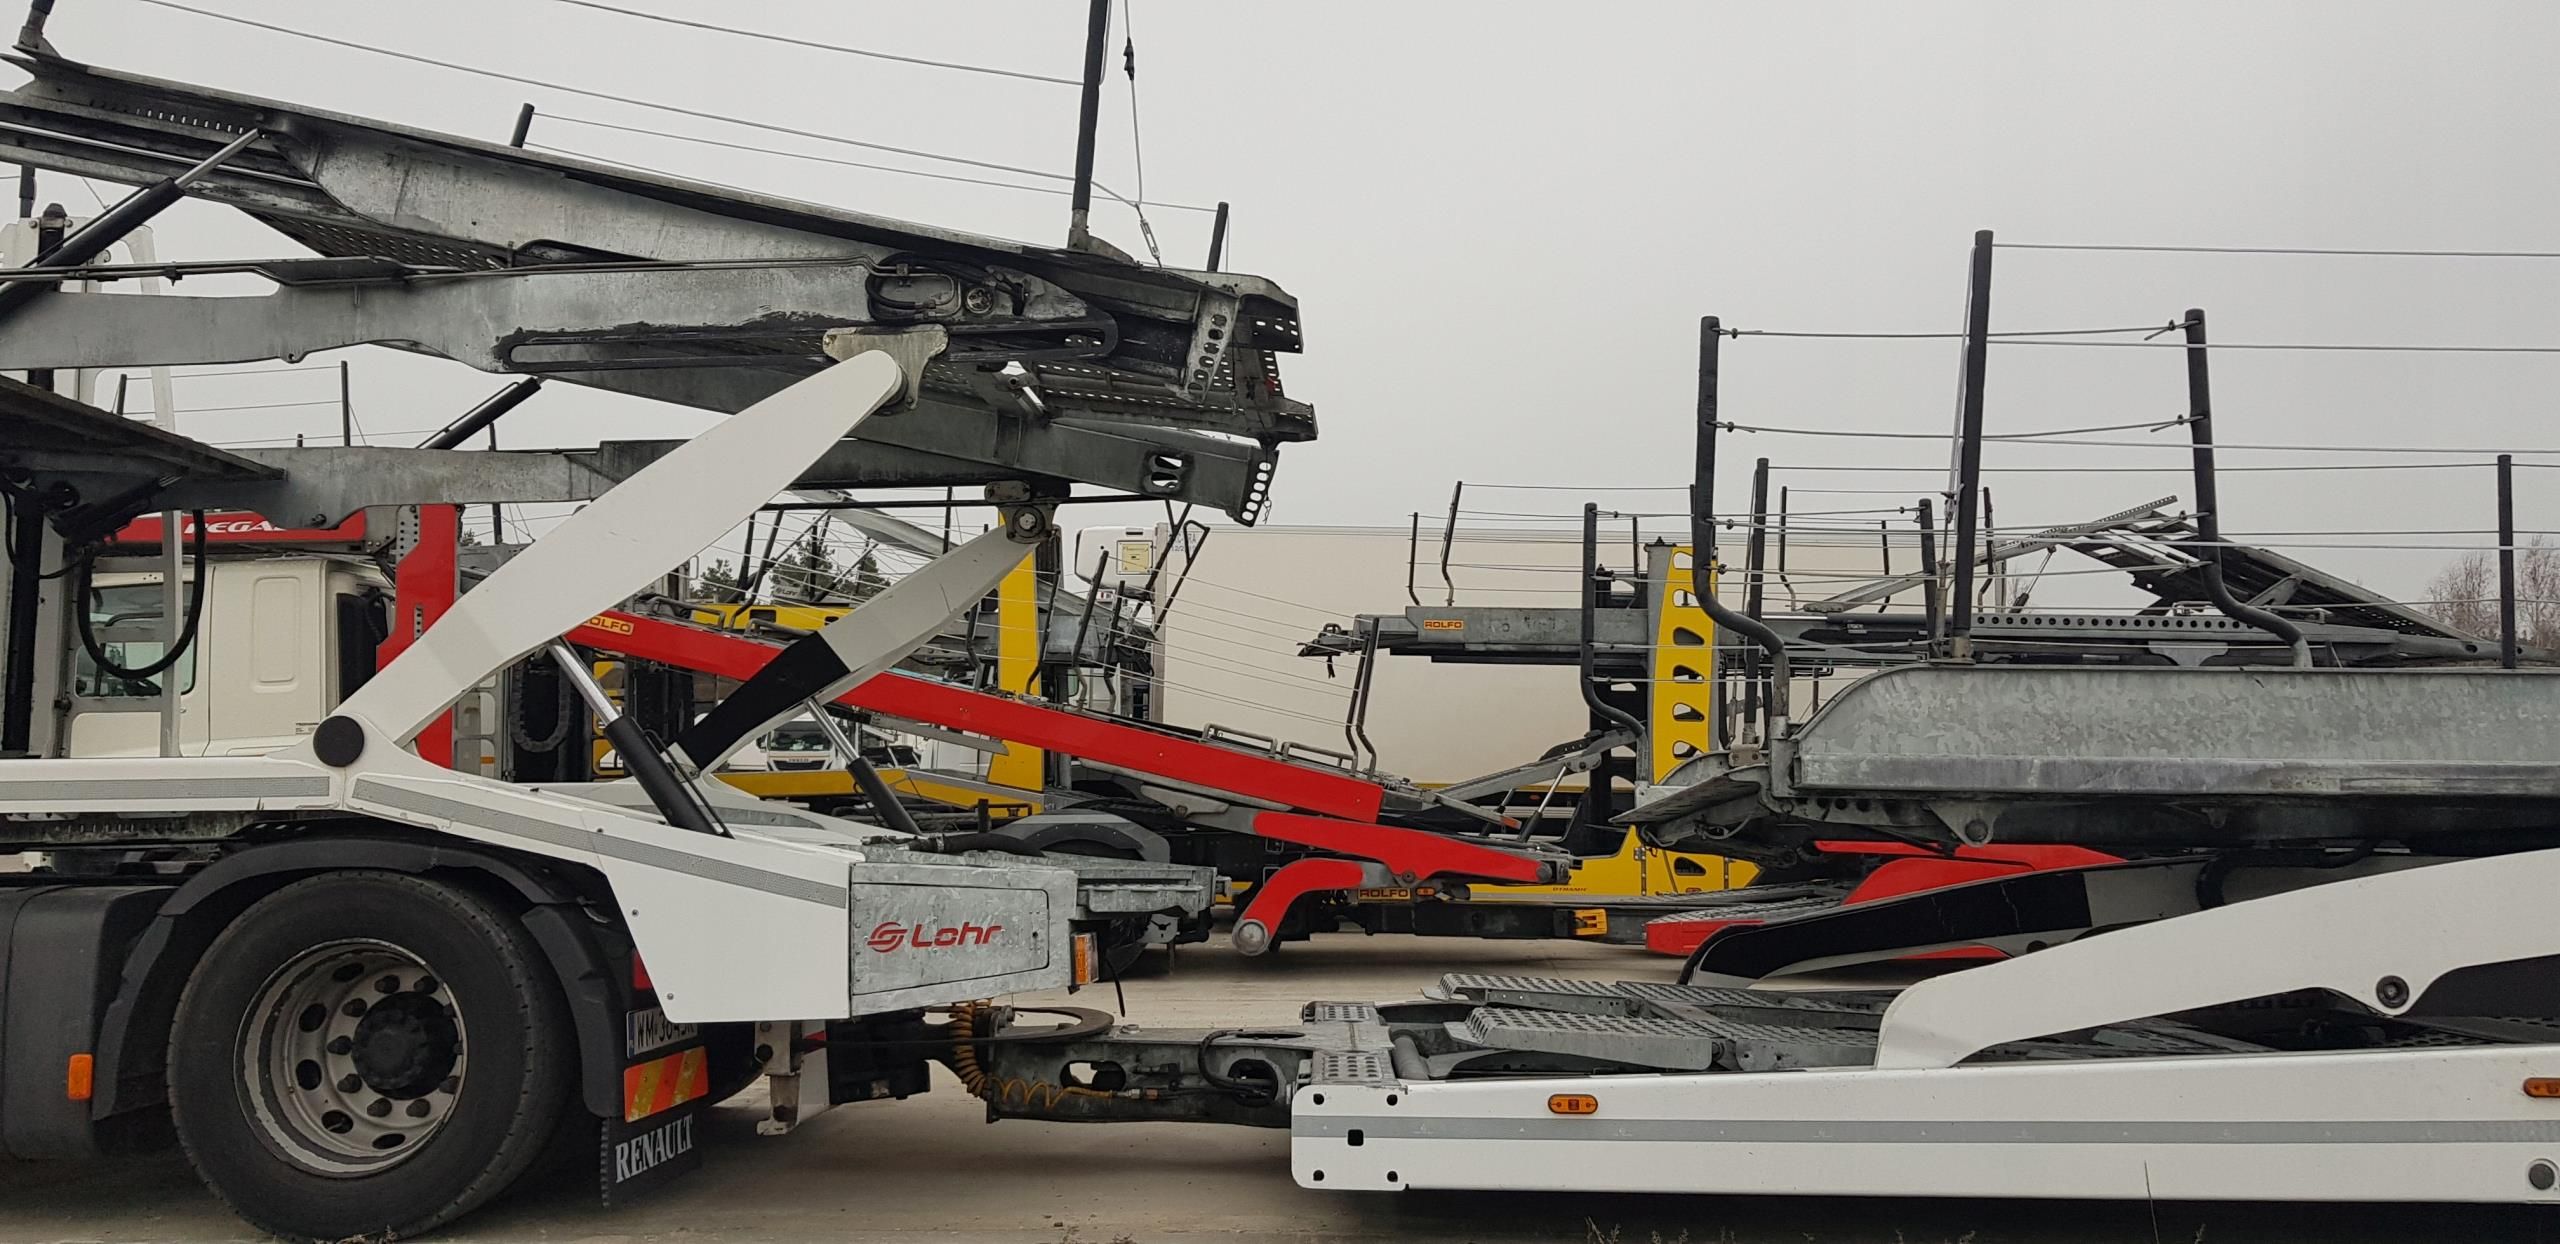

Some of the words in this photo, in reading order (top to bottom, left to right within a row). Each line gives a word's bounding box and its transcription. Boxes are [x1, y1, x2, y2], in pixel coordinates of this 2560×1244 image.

[585, 616, 631, 633] OLFO
[1360, 889, 1408, 898] ROLFO
[911, 921, 1003, 948] Lohr
[637, 1011, 655, 1050] WM
[616, 1113, 693, 1184] RENAULT
